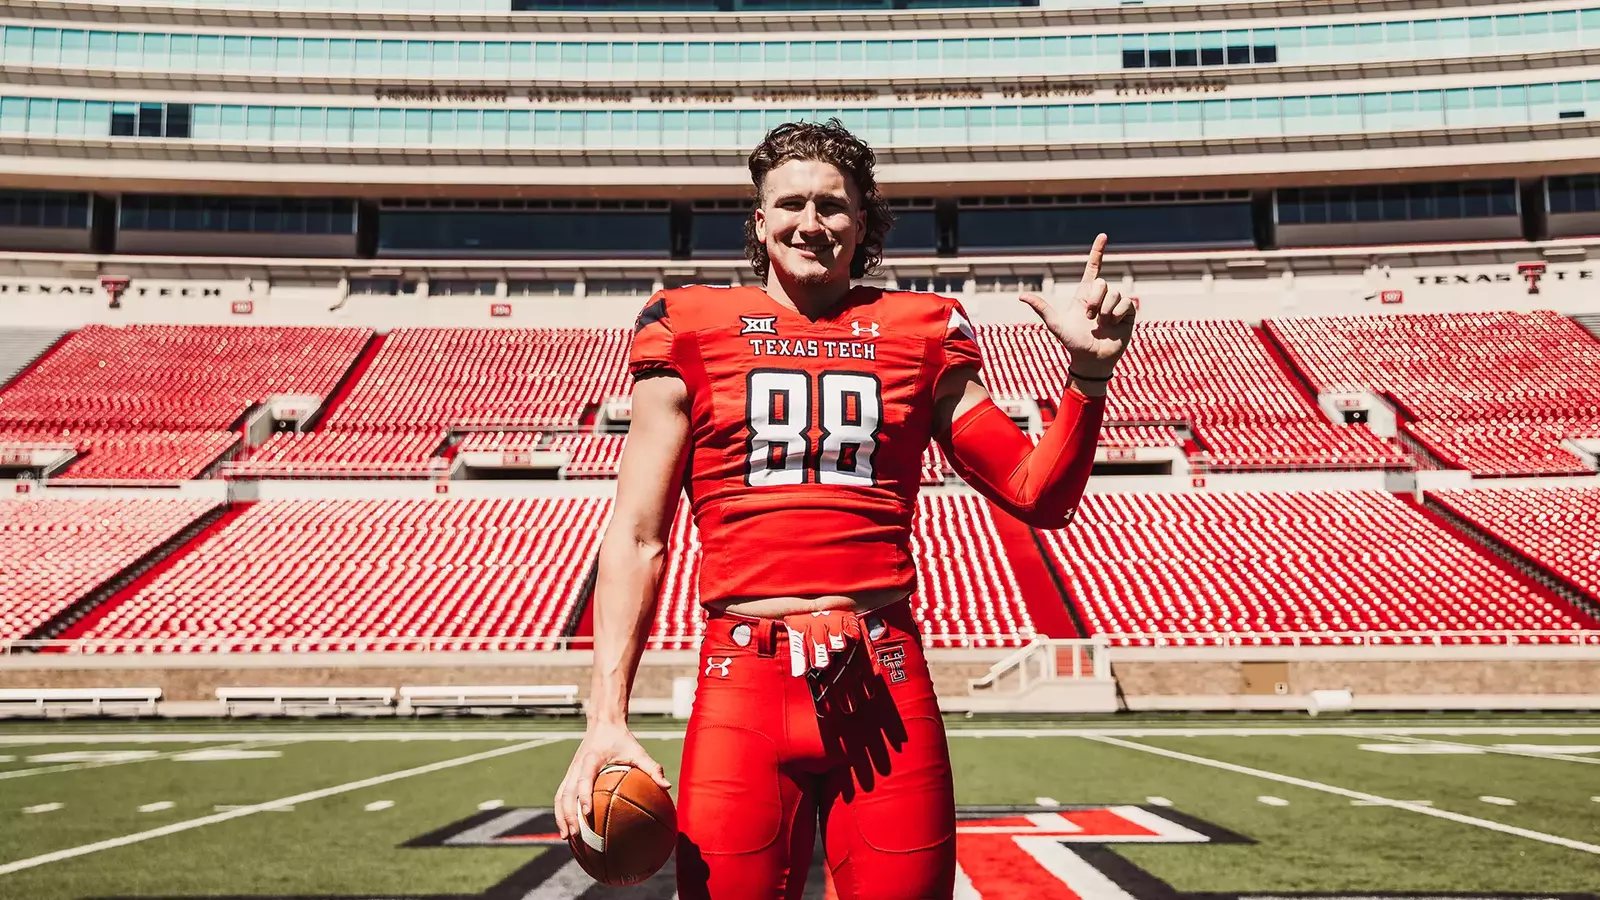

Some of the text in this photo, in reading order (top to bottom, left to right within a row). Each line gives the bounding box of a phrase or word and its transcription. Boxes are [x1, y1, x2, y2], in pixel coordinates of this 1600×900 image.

[1415, 273, 1511, 285] TEXAS
[138, 287, 221, 297] TECH
[749, 338, 876, 360] TEXAS TECH
[746, 368, 883, 487] 88
